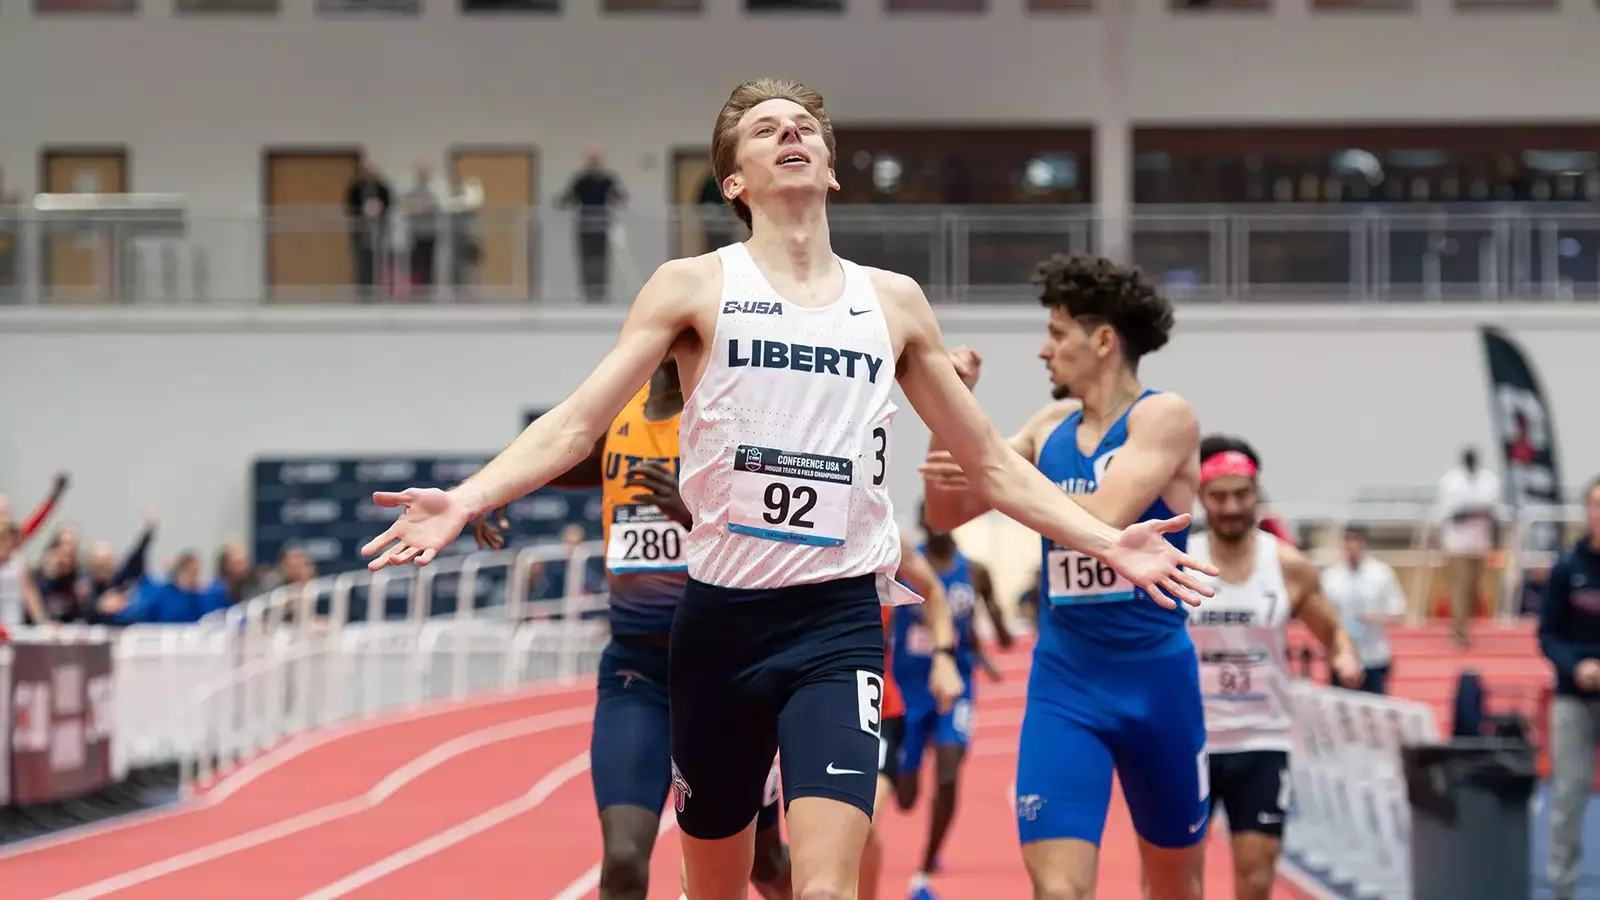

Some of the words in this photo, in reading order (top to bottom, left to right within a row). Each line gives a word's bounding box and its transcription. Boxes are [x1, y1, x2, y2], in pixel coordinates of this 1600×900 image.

[728, 339, 883, 384] LIBERTY
[765, 465, 782, 473] INDOOR
[782, 467, 797, 475] TRACK
[801, 469, 814, 477] FIELD
[814, 472, 851, 481] CHAMPIONSHIPS
[777, 455, 824, 470] CONFERENCE
[825, 461, 840, 472] USA
[872, 427, 887, 486] 3
[762, 482, 818, 529] 92
[622, 528, 681, 561] 280
[1059, 556, 1117, 590] 156
[867, 676, 881, 733] 3
